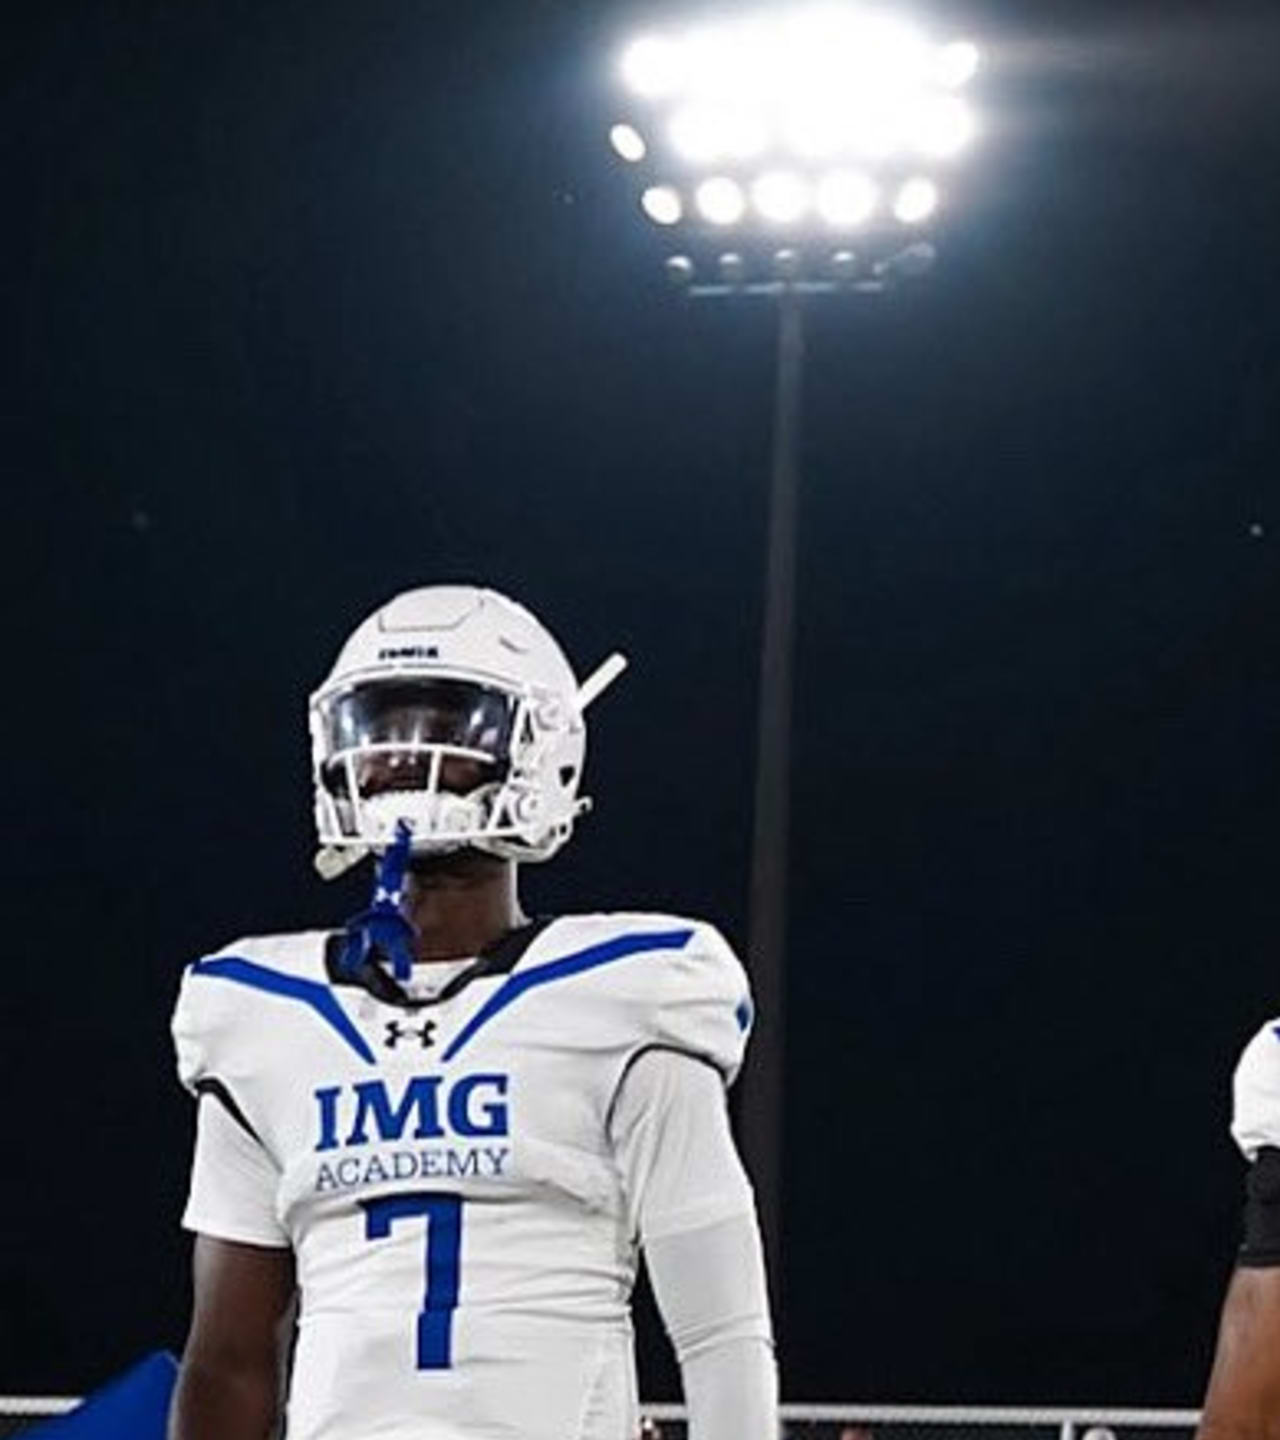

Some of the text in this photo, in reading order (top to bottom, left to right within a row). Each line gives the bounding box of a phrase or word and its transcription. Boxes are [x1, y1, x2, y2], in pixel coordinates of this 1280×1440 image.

[314, 1073, 510, 1153] IMG
[314, 1146, 511, 1192] ACADEMY
[361, 1193, 463, 1371] 7
